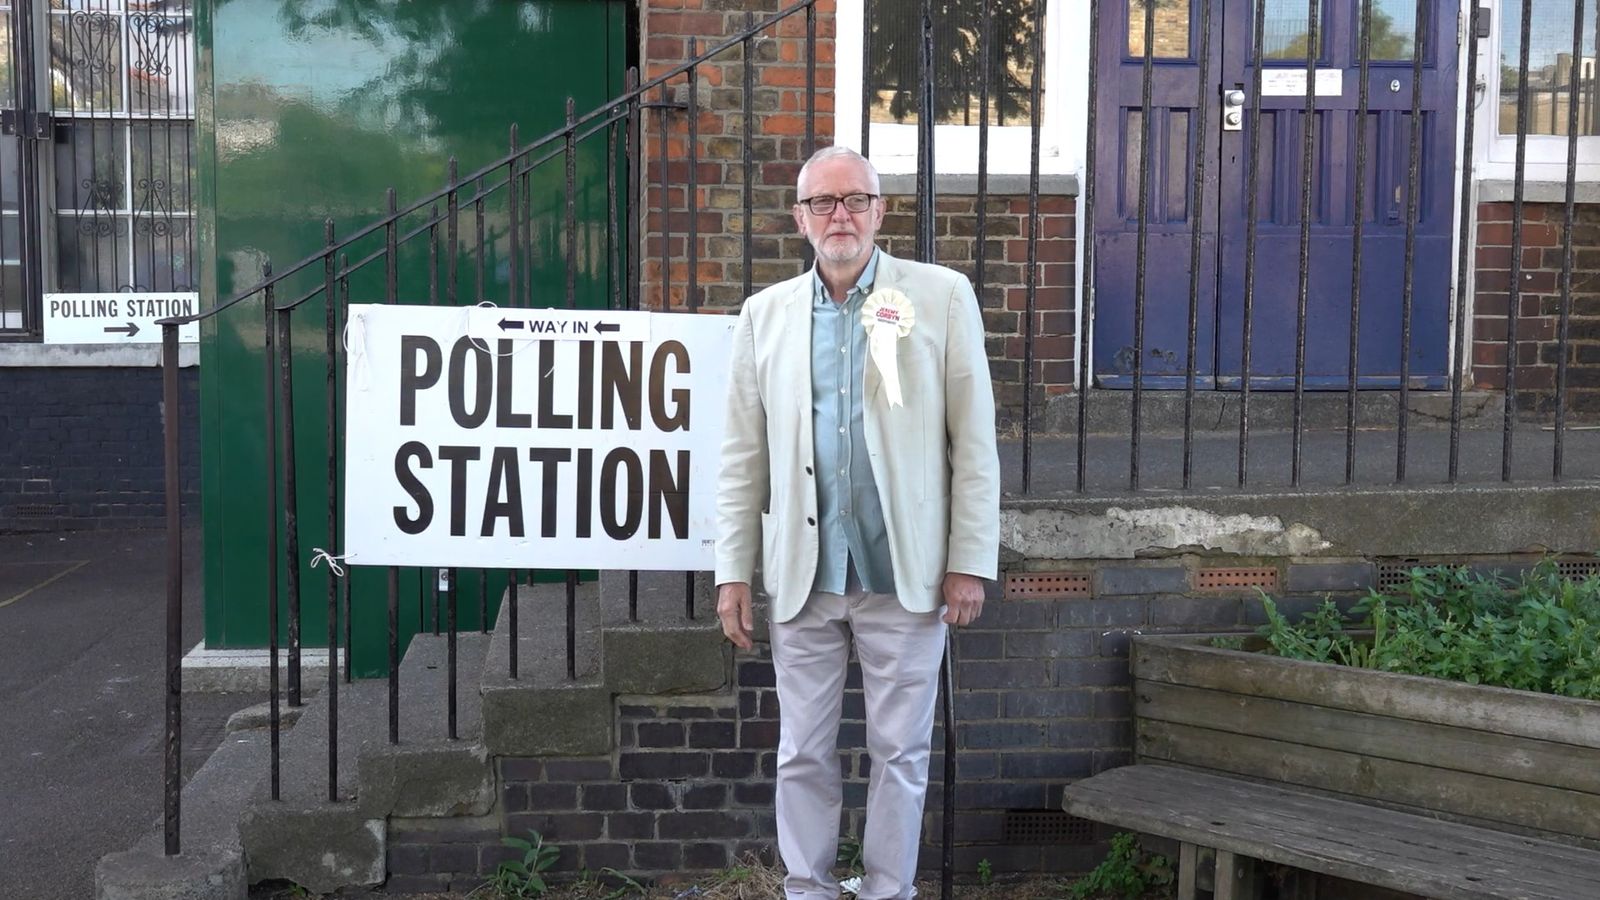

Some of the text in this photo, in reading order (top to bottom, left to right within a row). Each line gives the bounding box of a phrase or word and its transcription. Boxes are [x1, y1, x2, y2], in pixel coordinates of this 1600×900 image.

[51, 299, 192, 318] POLLING STATION
[875, 310, 900, 321] CORBYN
[528, 320, 589, 333] WAY IN
[400, 335, 691, 433] POLLING
[393, 441, 691, 540] STATION
